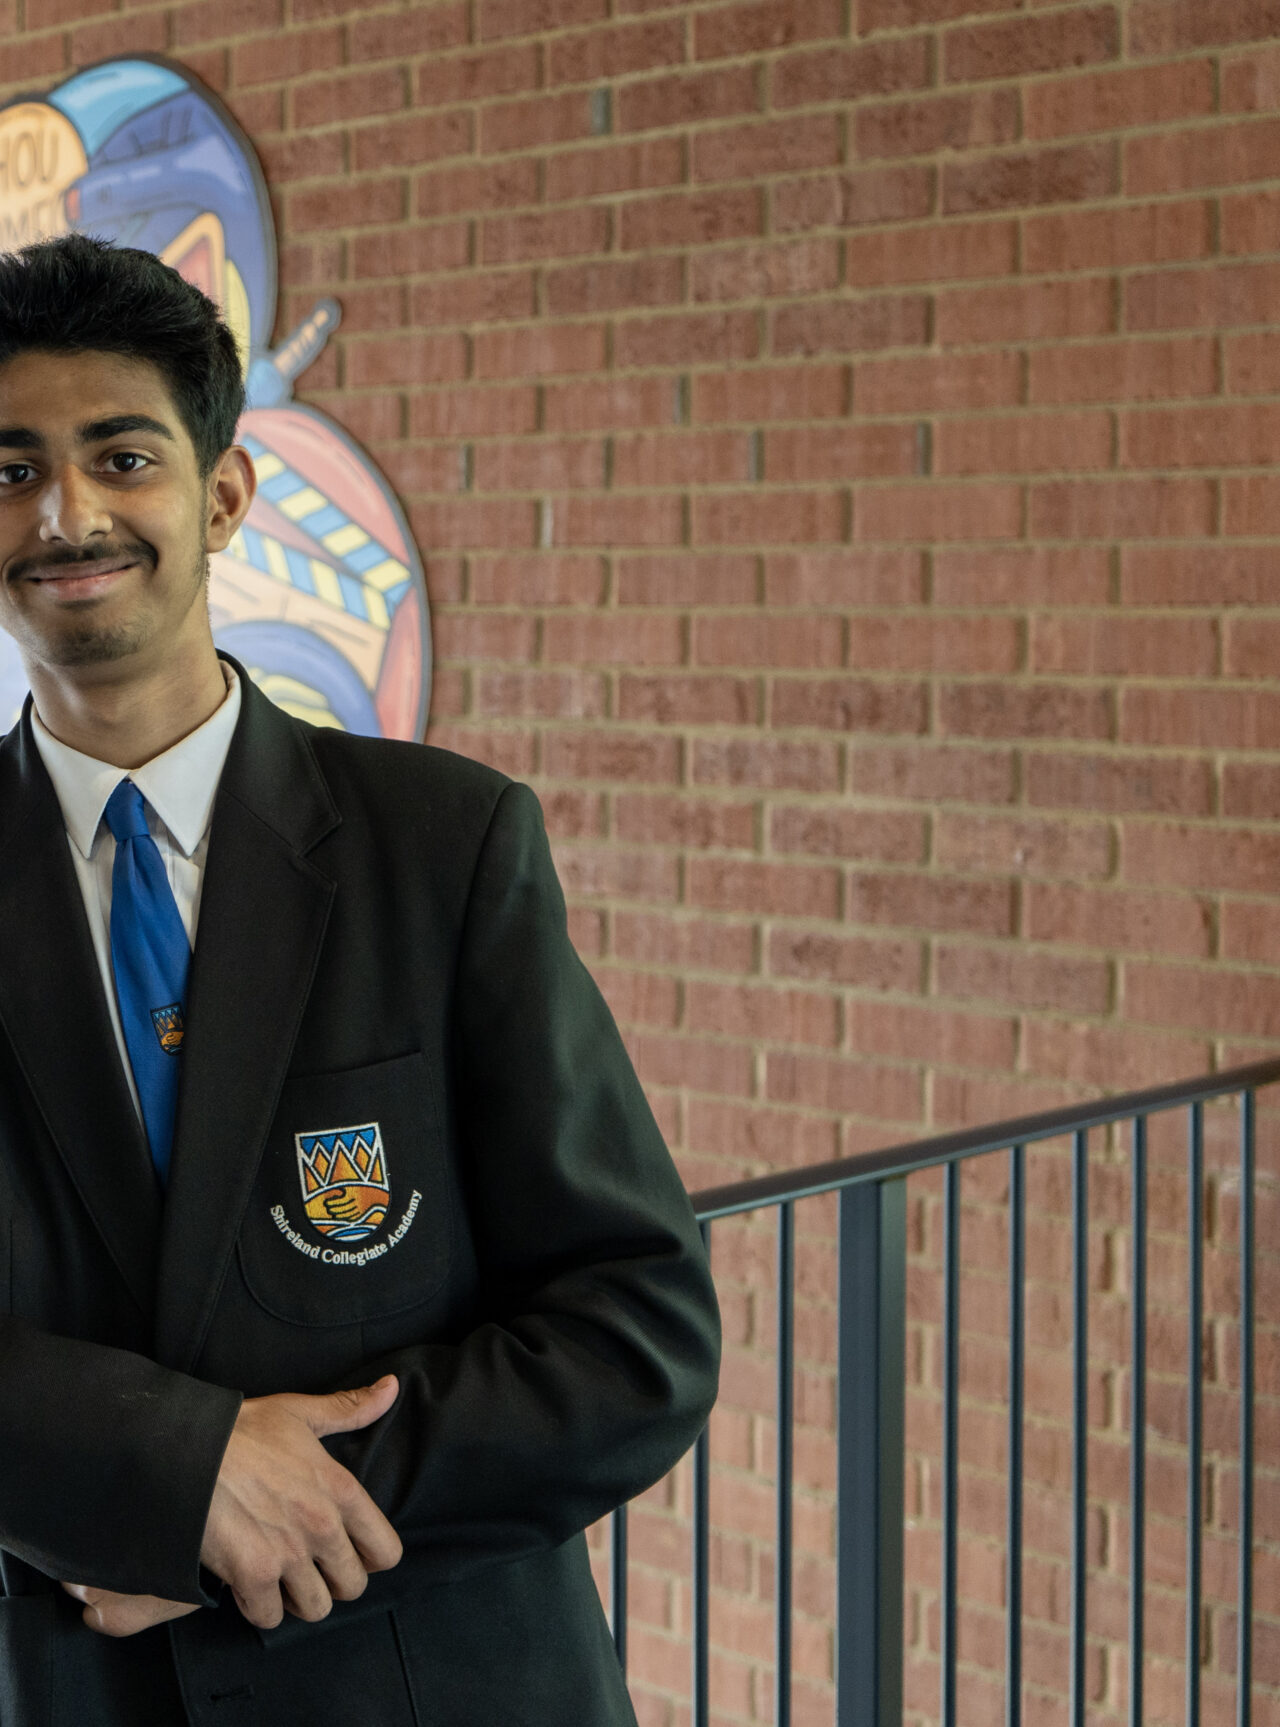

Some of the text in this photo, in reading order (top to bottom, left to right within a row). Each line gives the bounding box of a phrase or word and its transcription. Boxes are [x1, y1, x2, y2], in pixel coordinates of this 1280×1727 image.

[270, 1189, 423, 1266] Shireland Collegiate Academy
